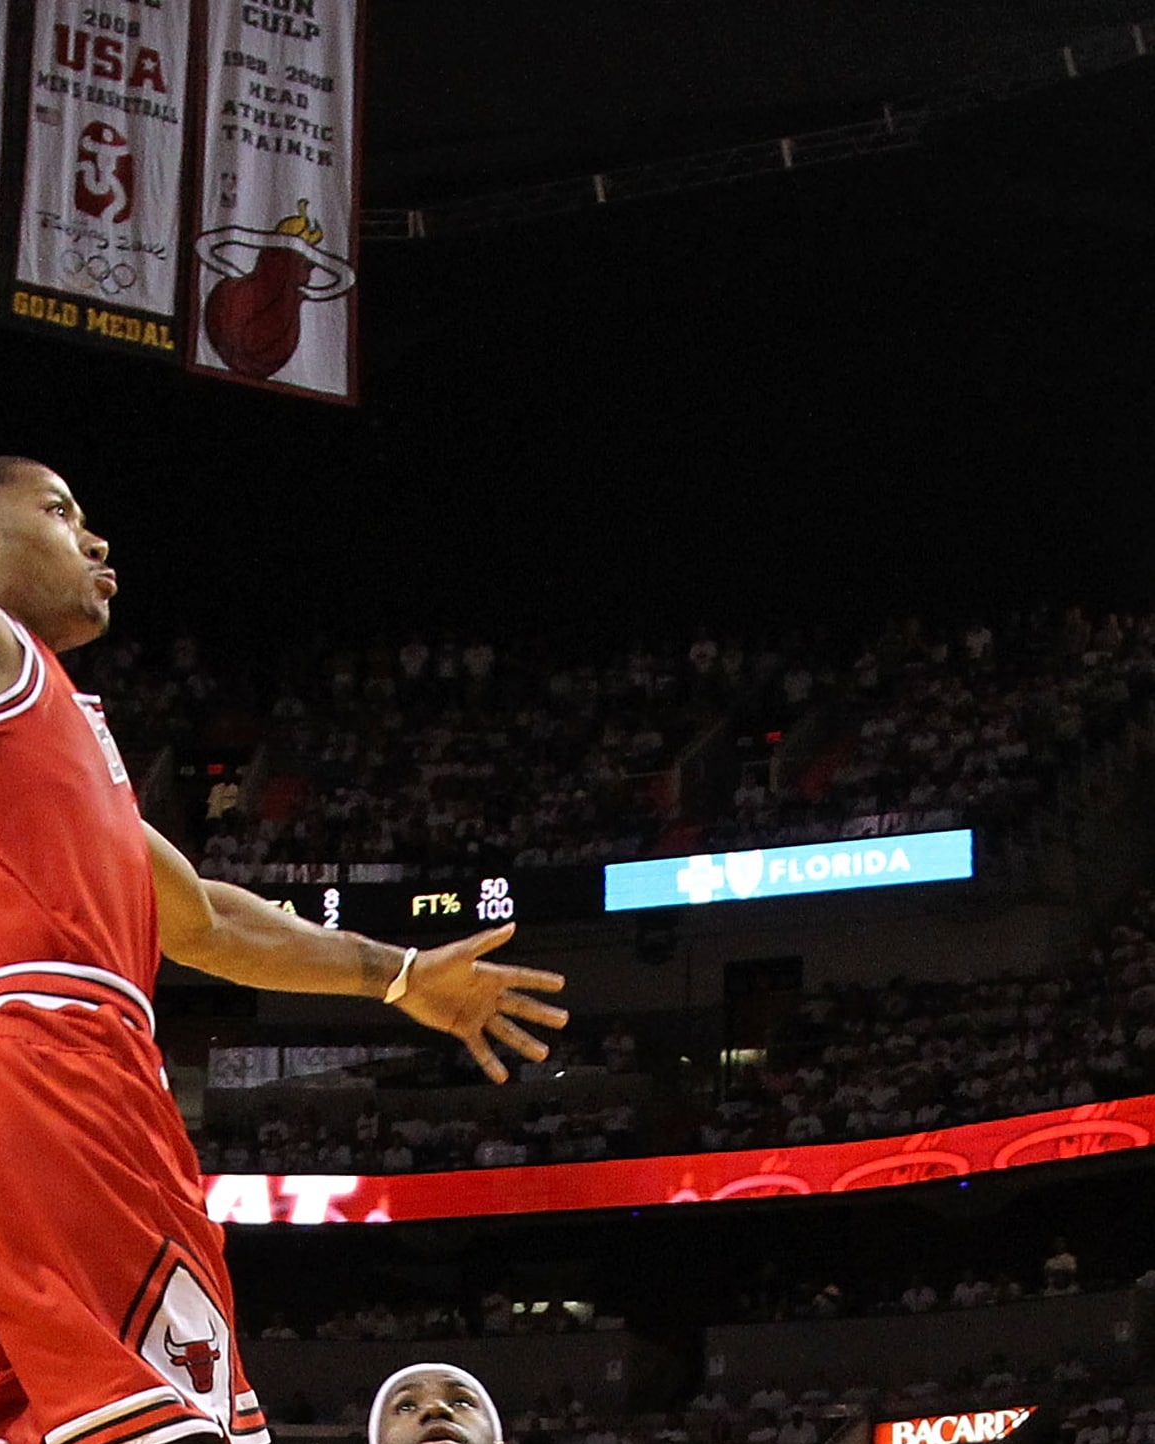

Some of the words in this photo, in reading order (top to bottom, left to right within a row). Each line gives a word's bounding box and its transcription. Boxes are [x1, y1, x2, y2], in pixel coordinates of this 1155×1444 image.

[83, 9, 140, 38] 2008
[243, 5, 320, 41] CULP
[54, 23, 166, 93] USA
[249, 81, 309, 109] HEAD
[221, 100, 333, 141] ATHLETIC
[221, 124, 333, 167] TRAINER
[13, 291, 78, 328] GOLD
[86, 307, 175, 350] MEDAL
[768, 848, 911, 884] FLORIDA
[323, 888, 340, 909] 8
[480, 878, 508, 899] 50
[323, 908, 339, 929] 2
[411, 893, 462, 917] FT%
[475, 897, 514, 920] 100
[205, 1174, 359, 1225] AT
